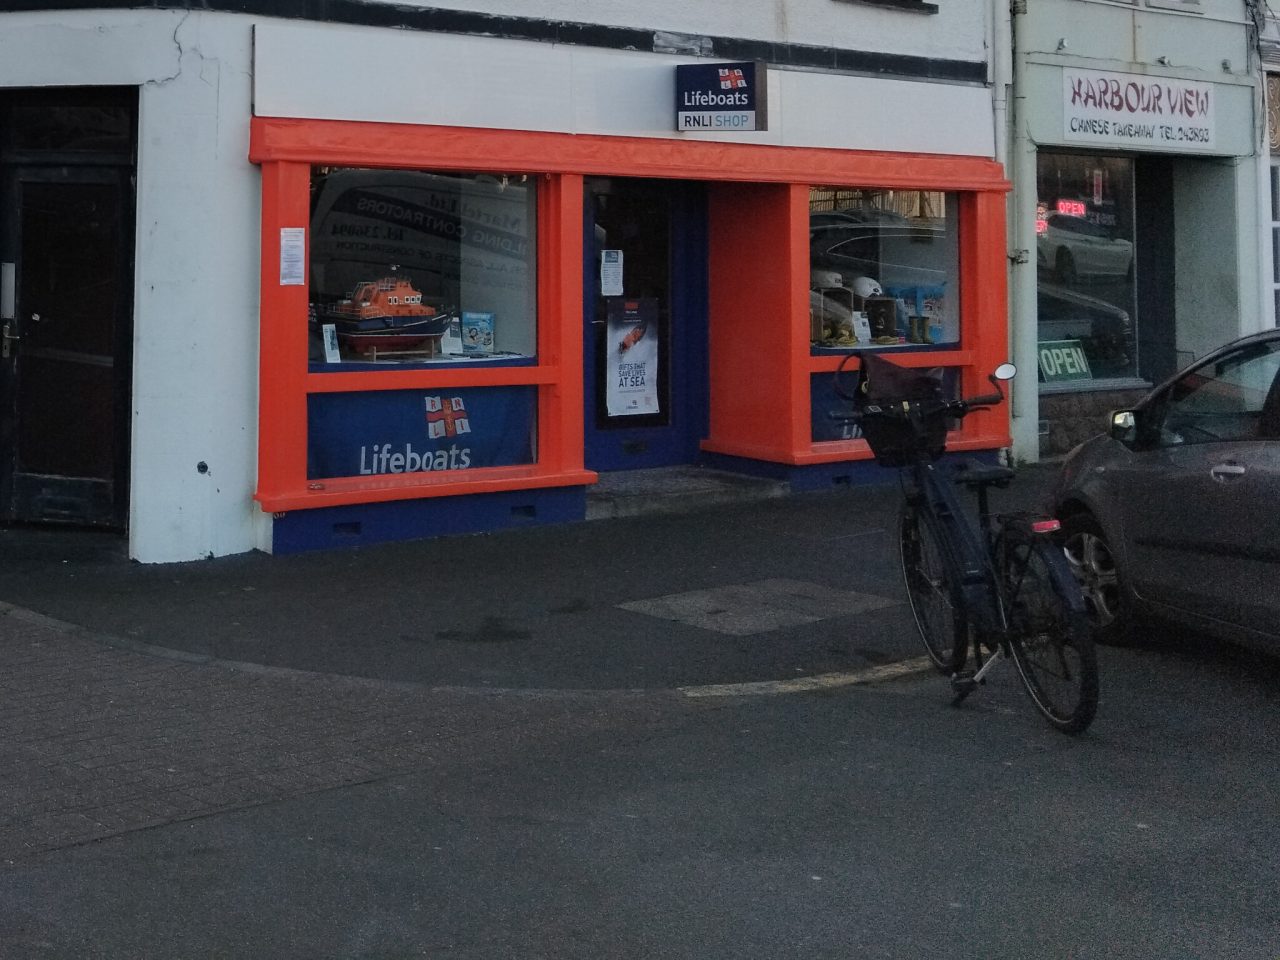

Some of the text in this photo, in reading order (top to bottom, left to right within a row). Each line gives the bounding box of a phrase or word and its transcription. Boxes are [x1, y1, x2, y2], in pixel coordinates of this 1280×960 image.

[684, 91, 748, 106] Lifeboats
[1071, 76, 1209, 118] HARBOUR VIEW
[684, 115, 748, 127] RNLI SHOP
[1071, 117, 1109, 135] CHINESE
[1113, 122, 1155, 139] TAKEAWAY
[1059, 201, 1085, 216] OPEN
[1040, 348, 1088, 376] OPEN
[618, 376, 645, 388] AT SEA
[360, 443, 471, 474] Lifeboats
